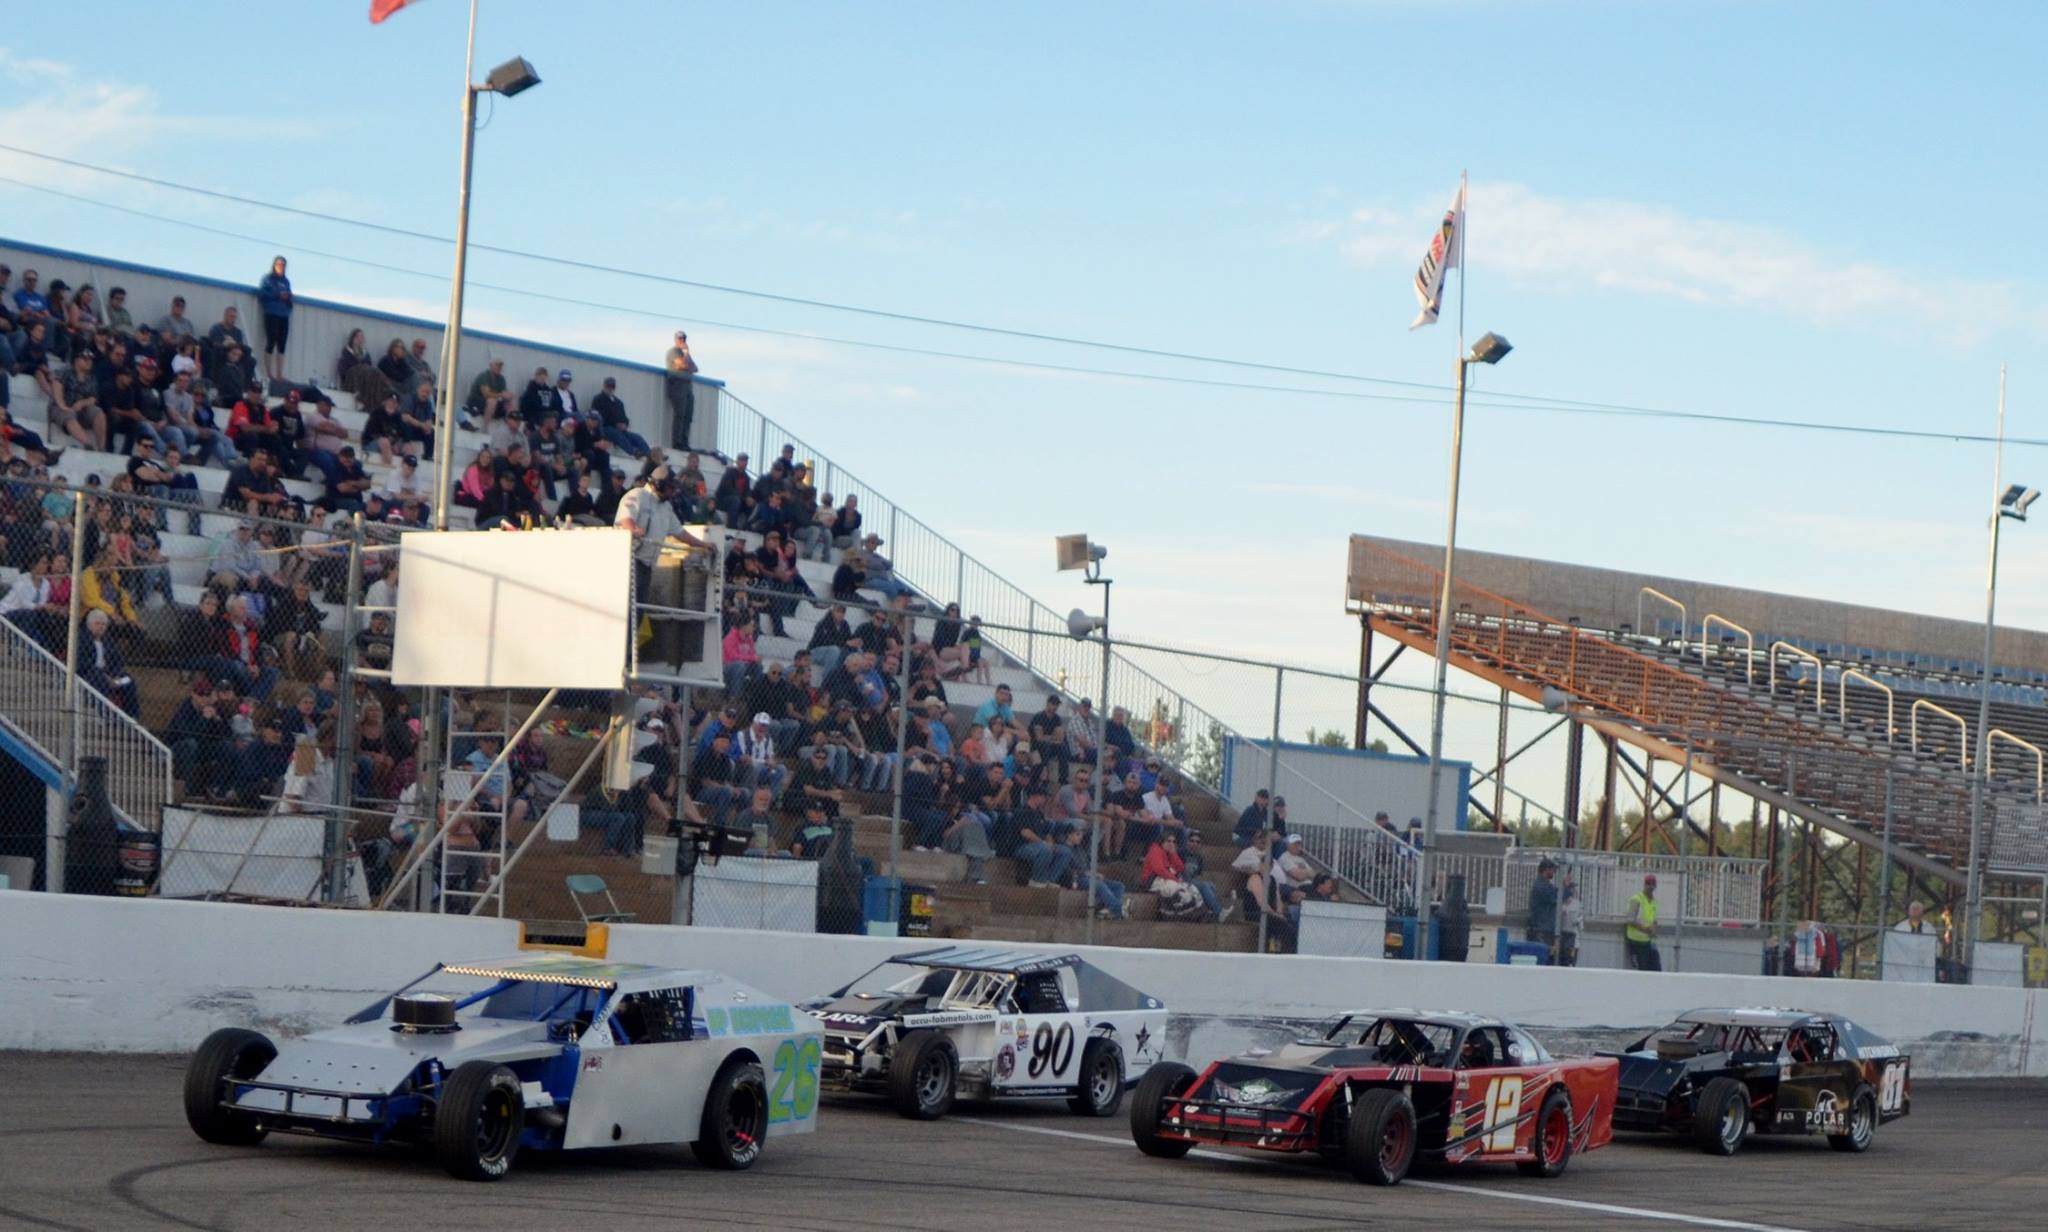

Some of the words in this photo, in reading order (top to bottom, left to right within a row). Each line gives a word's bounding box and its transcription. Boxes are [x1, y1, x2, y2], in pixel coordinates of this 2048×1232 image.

[766, 1036, 821, 1123] 26
[1028, 1021, 1075, 1079] 90
[1481, 1076, 1521, 1151] 12
[1805, 1111, 1845, 1126] POLAR
